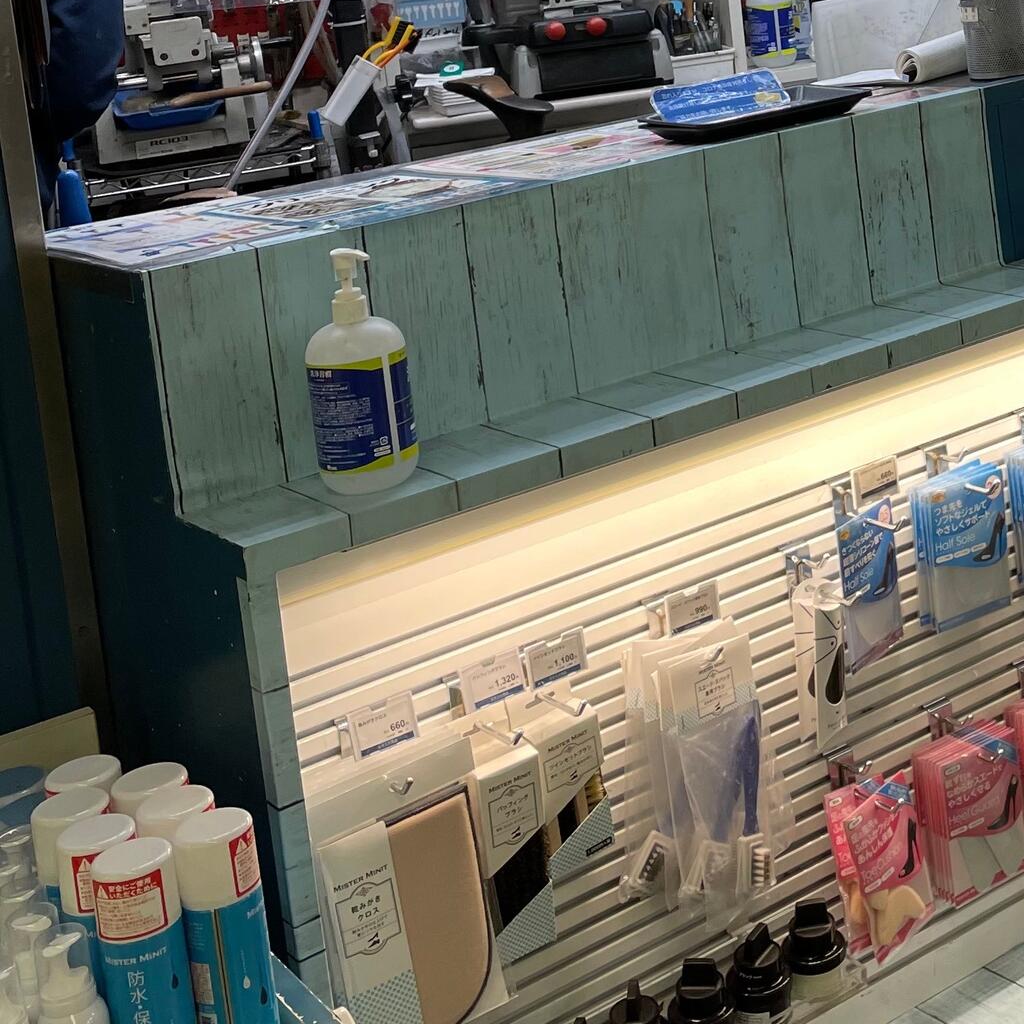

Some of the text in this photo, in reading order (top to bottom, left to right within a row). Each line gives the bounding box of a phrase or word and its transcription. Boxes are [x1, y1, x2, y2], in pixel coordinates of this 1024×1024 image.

[934, 500, 962, 516] つま先を
[935, 500, 987, 526] ソフトなジェルで
[936, 511, 991, 537] やさしくサポート
[935, 533, 976, 552] Half Sole
[844, 567, 874, 593] Half Sole
[333, 863, 388, 893] MISTER MINIT
[351, 895, 380, 913] 靴みがき
[357, 906, 380, 921] クロス
[139, 945, 167, 963] MINIT
